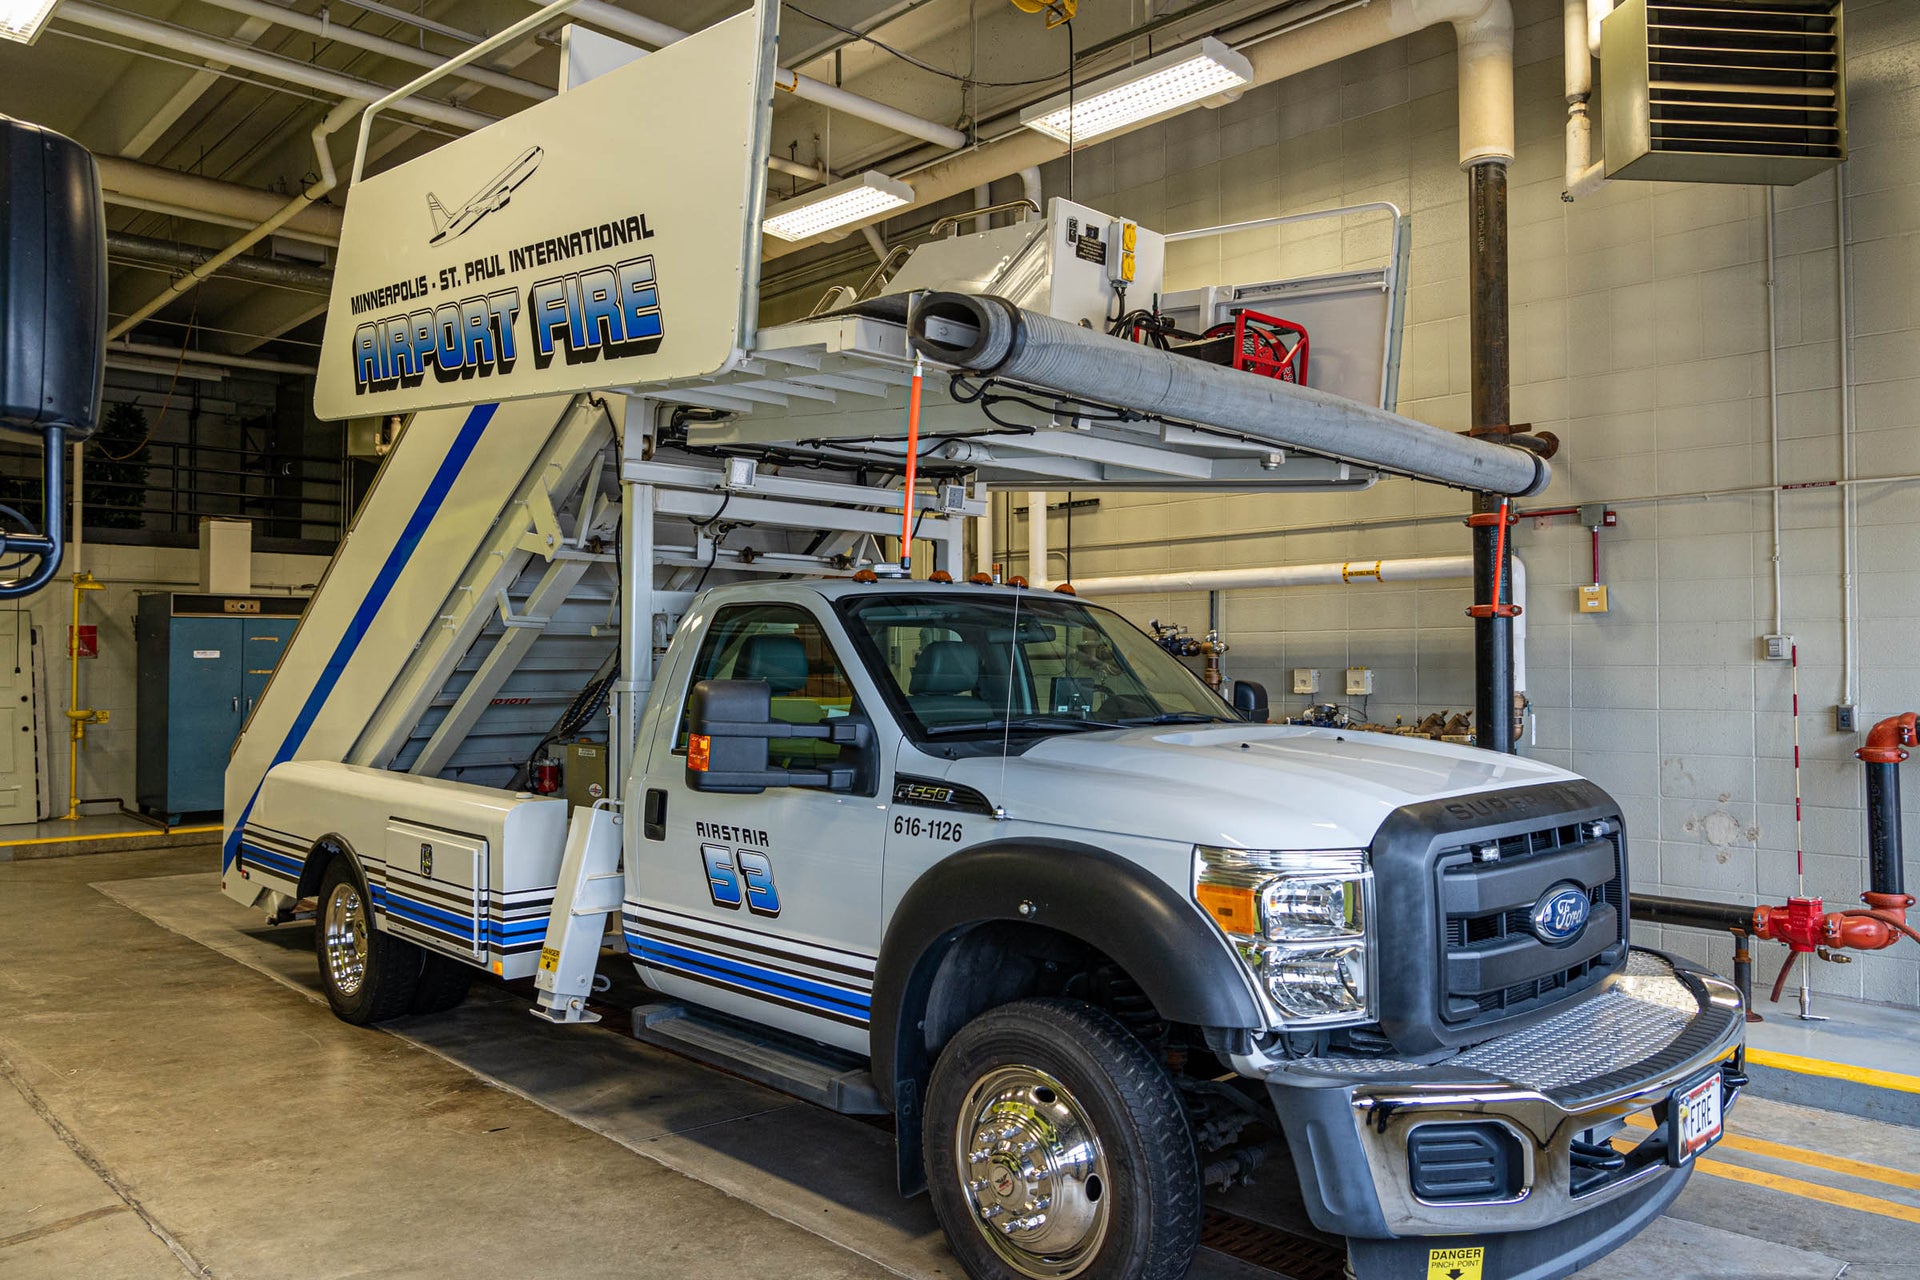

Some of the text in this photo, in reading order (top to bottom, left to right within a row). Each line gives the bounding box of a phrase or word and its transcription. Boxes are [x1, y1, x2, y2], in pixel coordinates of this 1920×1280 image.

[351, 275, 428, 316] MINNEAPOLIS
[439, 266, 461, 291] ST.
[465, 254, 505, 285] PAUL
[509, 213, 655, 273] INTERNATIONAL
[352, 254, 664, 395] AIRPORT FIRE
[696, 821, 769, 847] AIRSTAIR
[894, 815, 963, 842] 616-1126
[700, 842, 781, 919] 53
[1555, 897, 1584, 930] Ford
[1690, 1094, 1712, 1138] FIRE
[1432, 1249, 1481, 1260] DANGER
[1457, 1259, 1480, 1267] POINT
